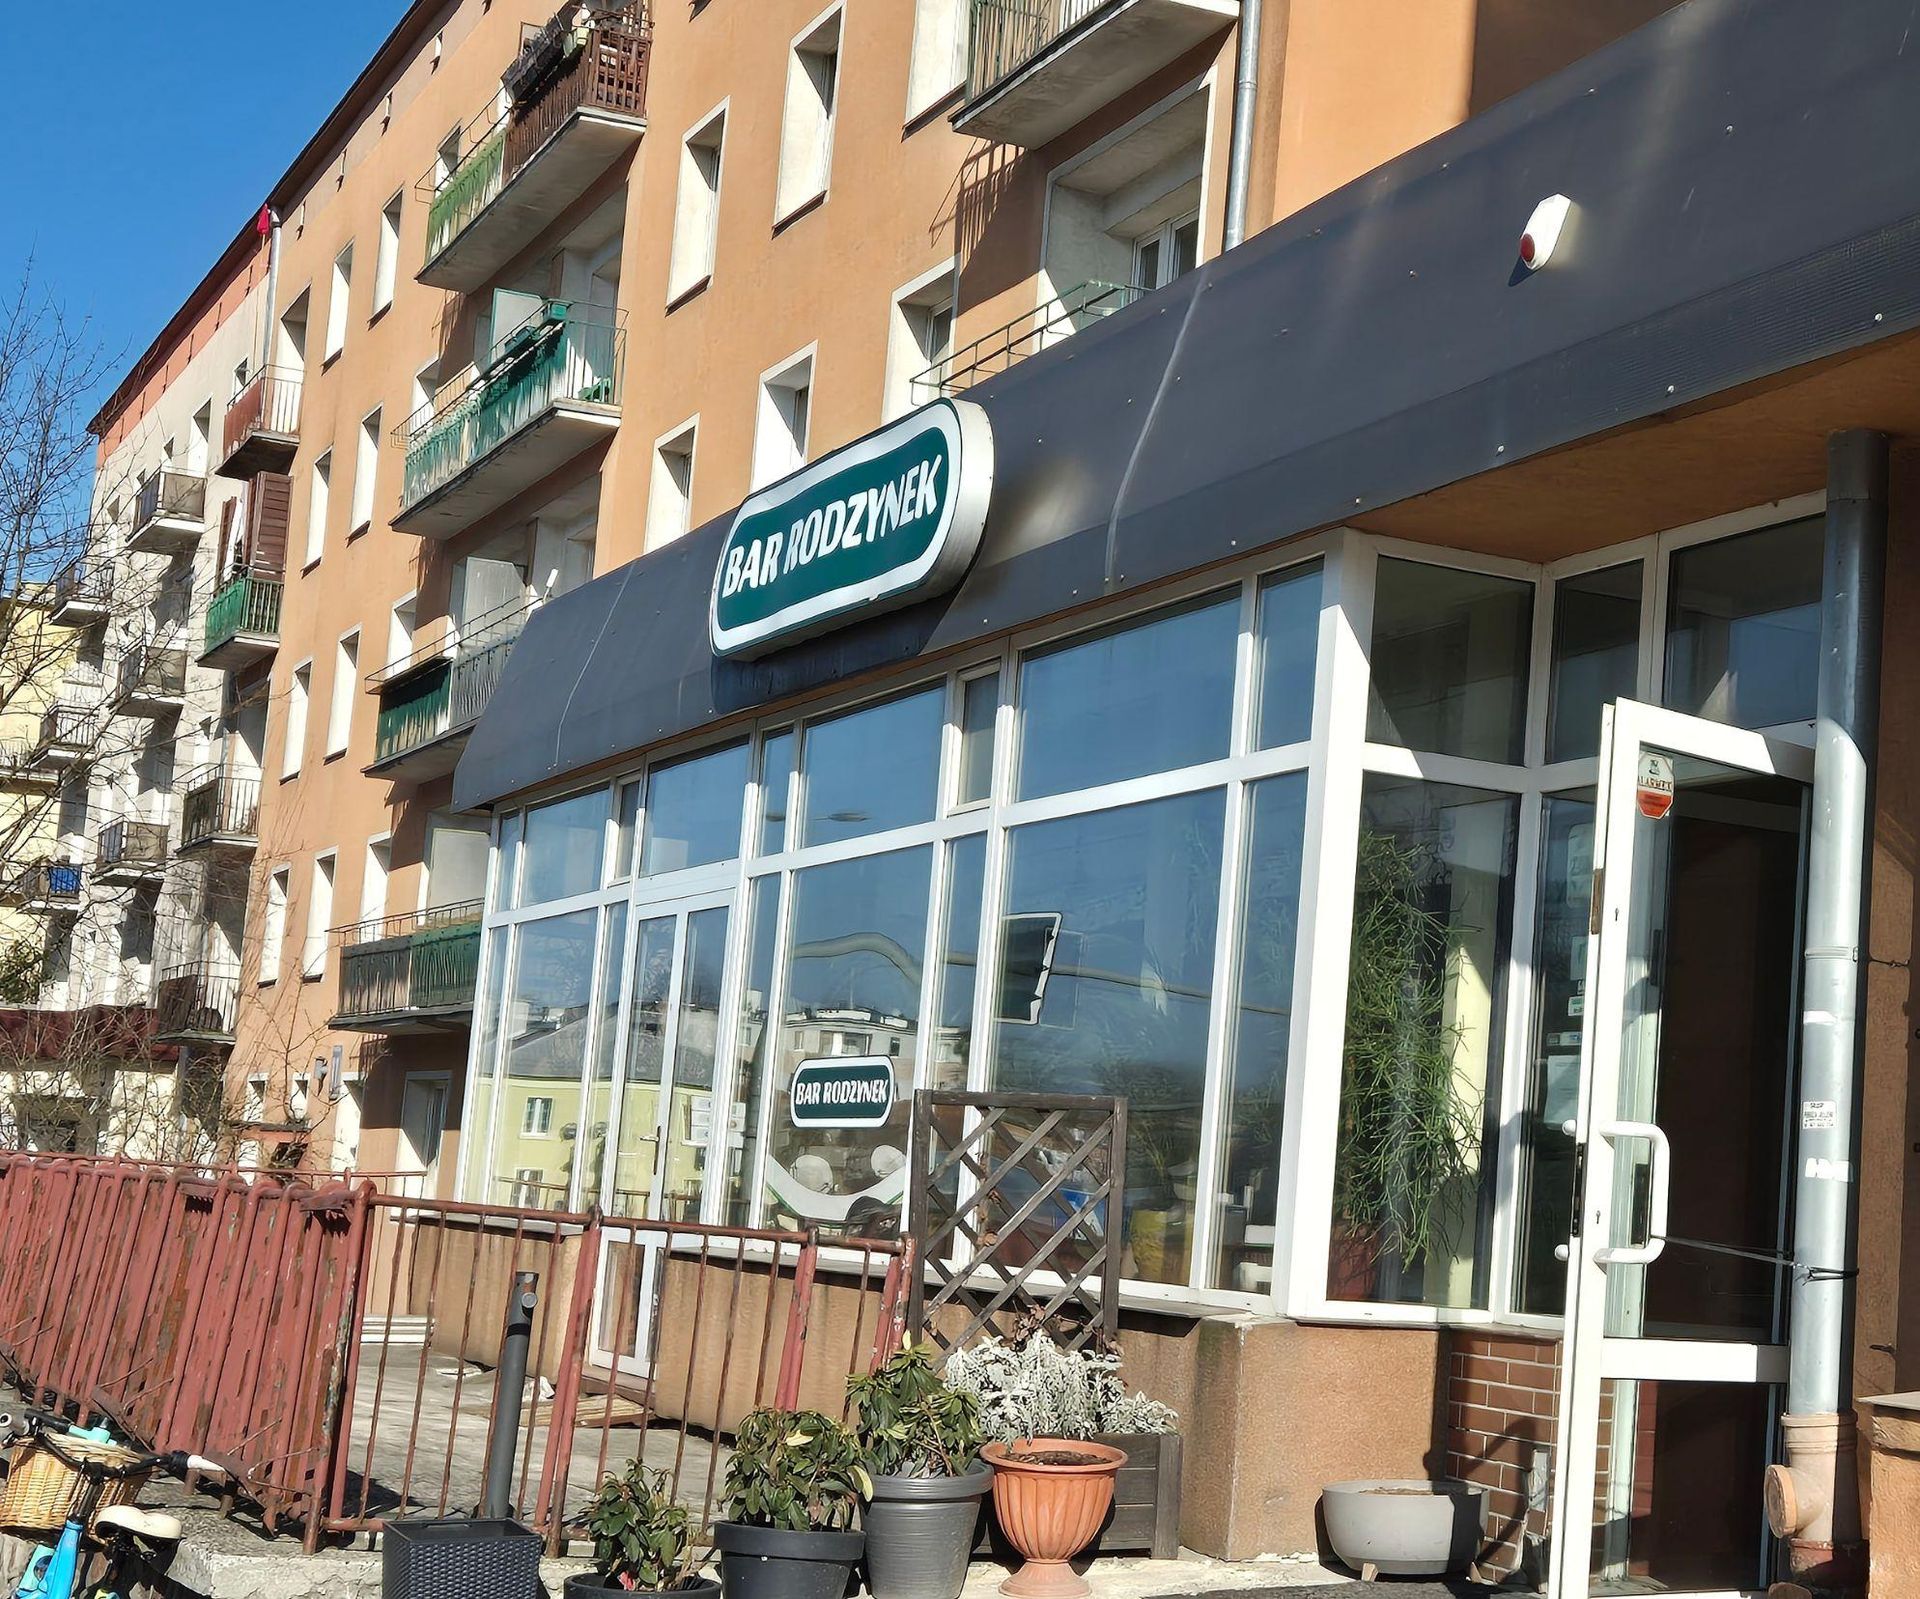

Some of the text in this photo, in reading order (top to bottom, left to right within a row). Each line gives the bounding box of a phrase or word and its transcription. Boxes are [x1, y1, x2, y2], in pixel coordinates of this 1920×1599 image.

[722, 454, 942, 598] BAR RODZYNEK
[795, 1079, 889, 1105] BAR RODZYNEK
